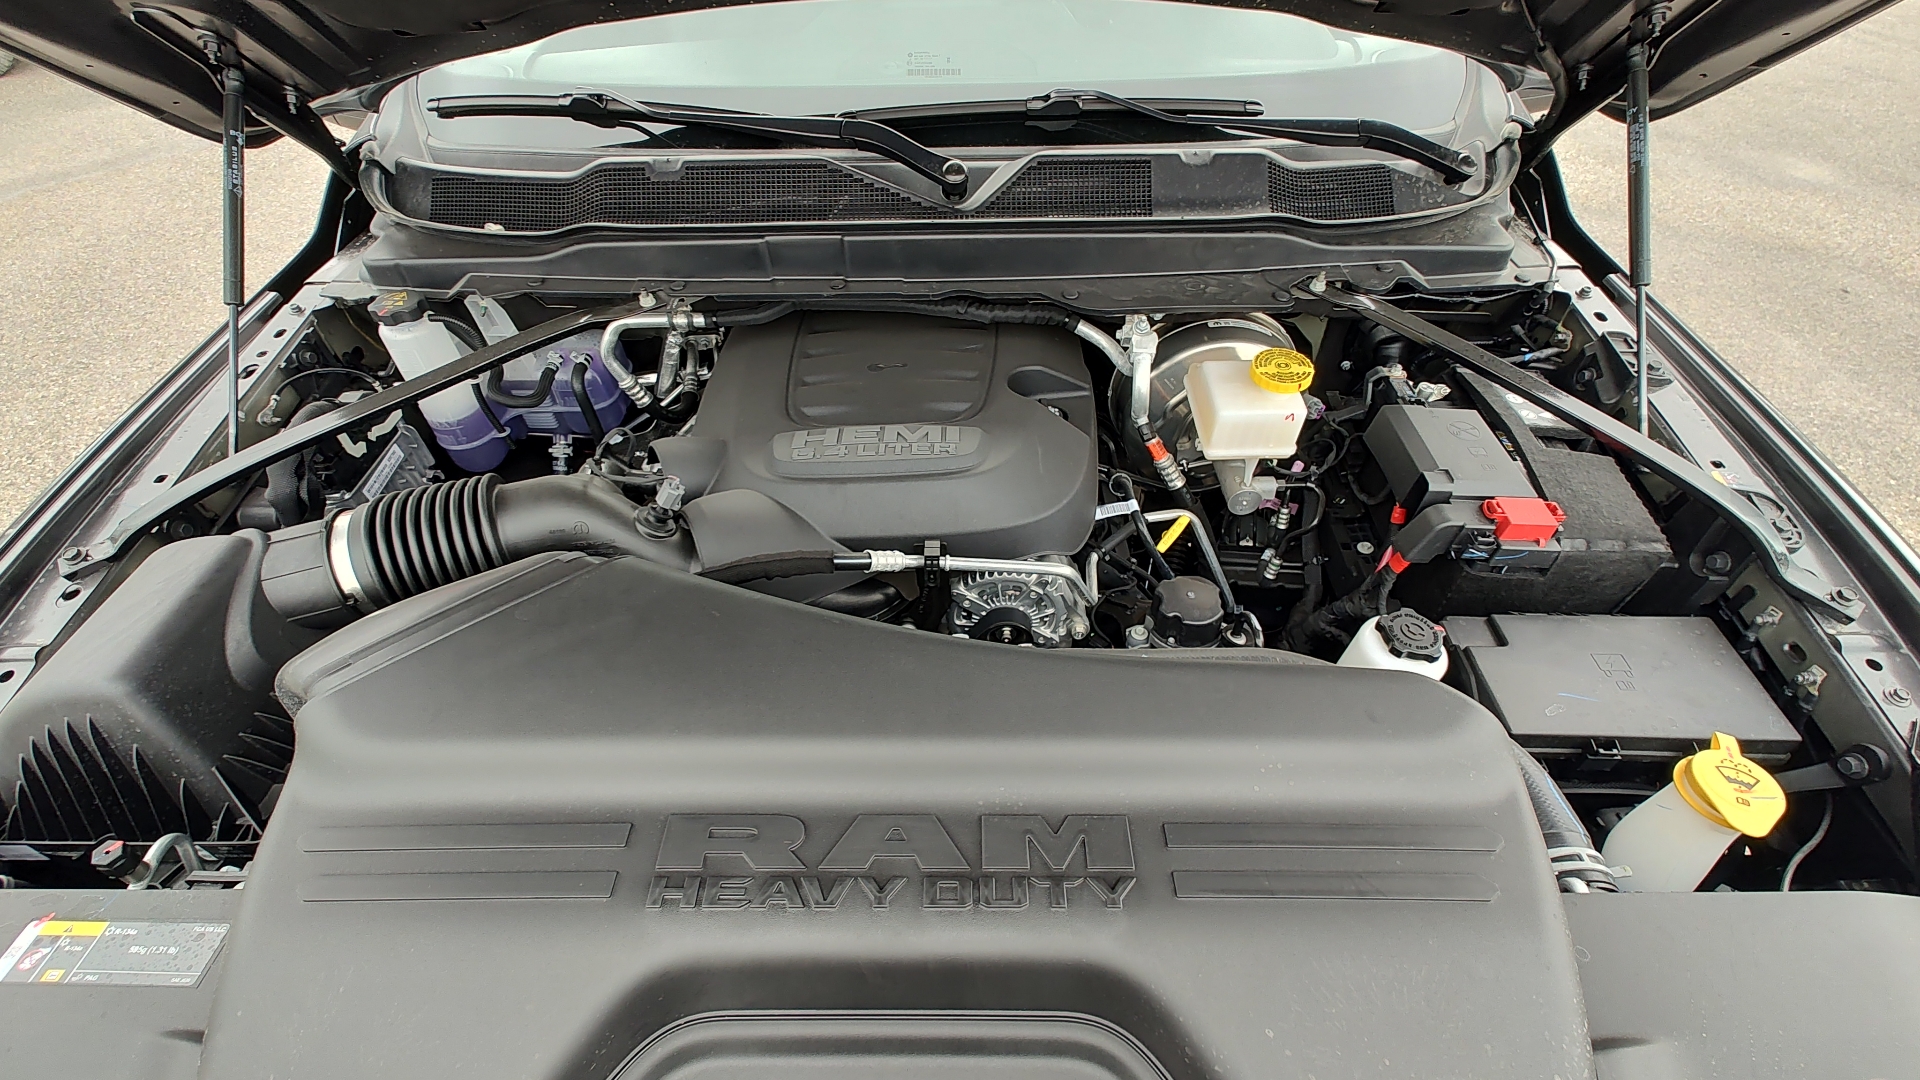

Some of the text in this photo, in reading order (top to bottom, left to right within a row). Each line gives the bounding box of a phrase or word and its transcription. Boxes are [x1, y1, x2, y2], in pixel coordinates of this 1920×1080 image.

[791, 425, 959, 449] HEMI
[791, 443, 958, 461] 6.4 LITER
[655, 813, 1136, 872] RAM
[645, 875, 1137, 910] HEAVY DUTY
